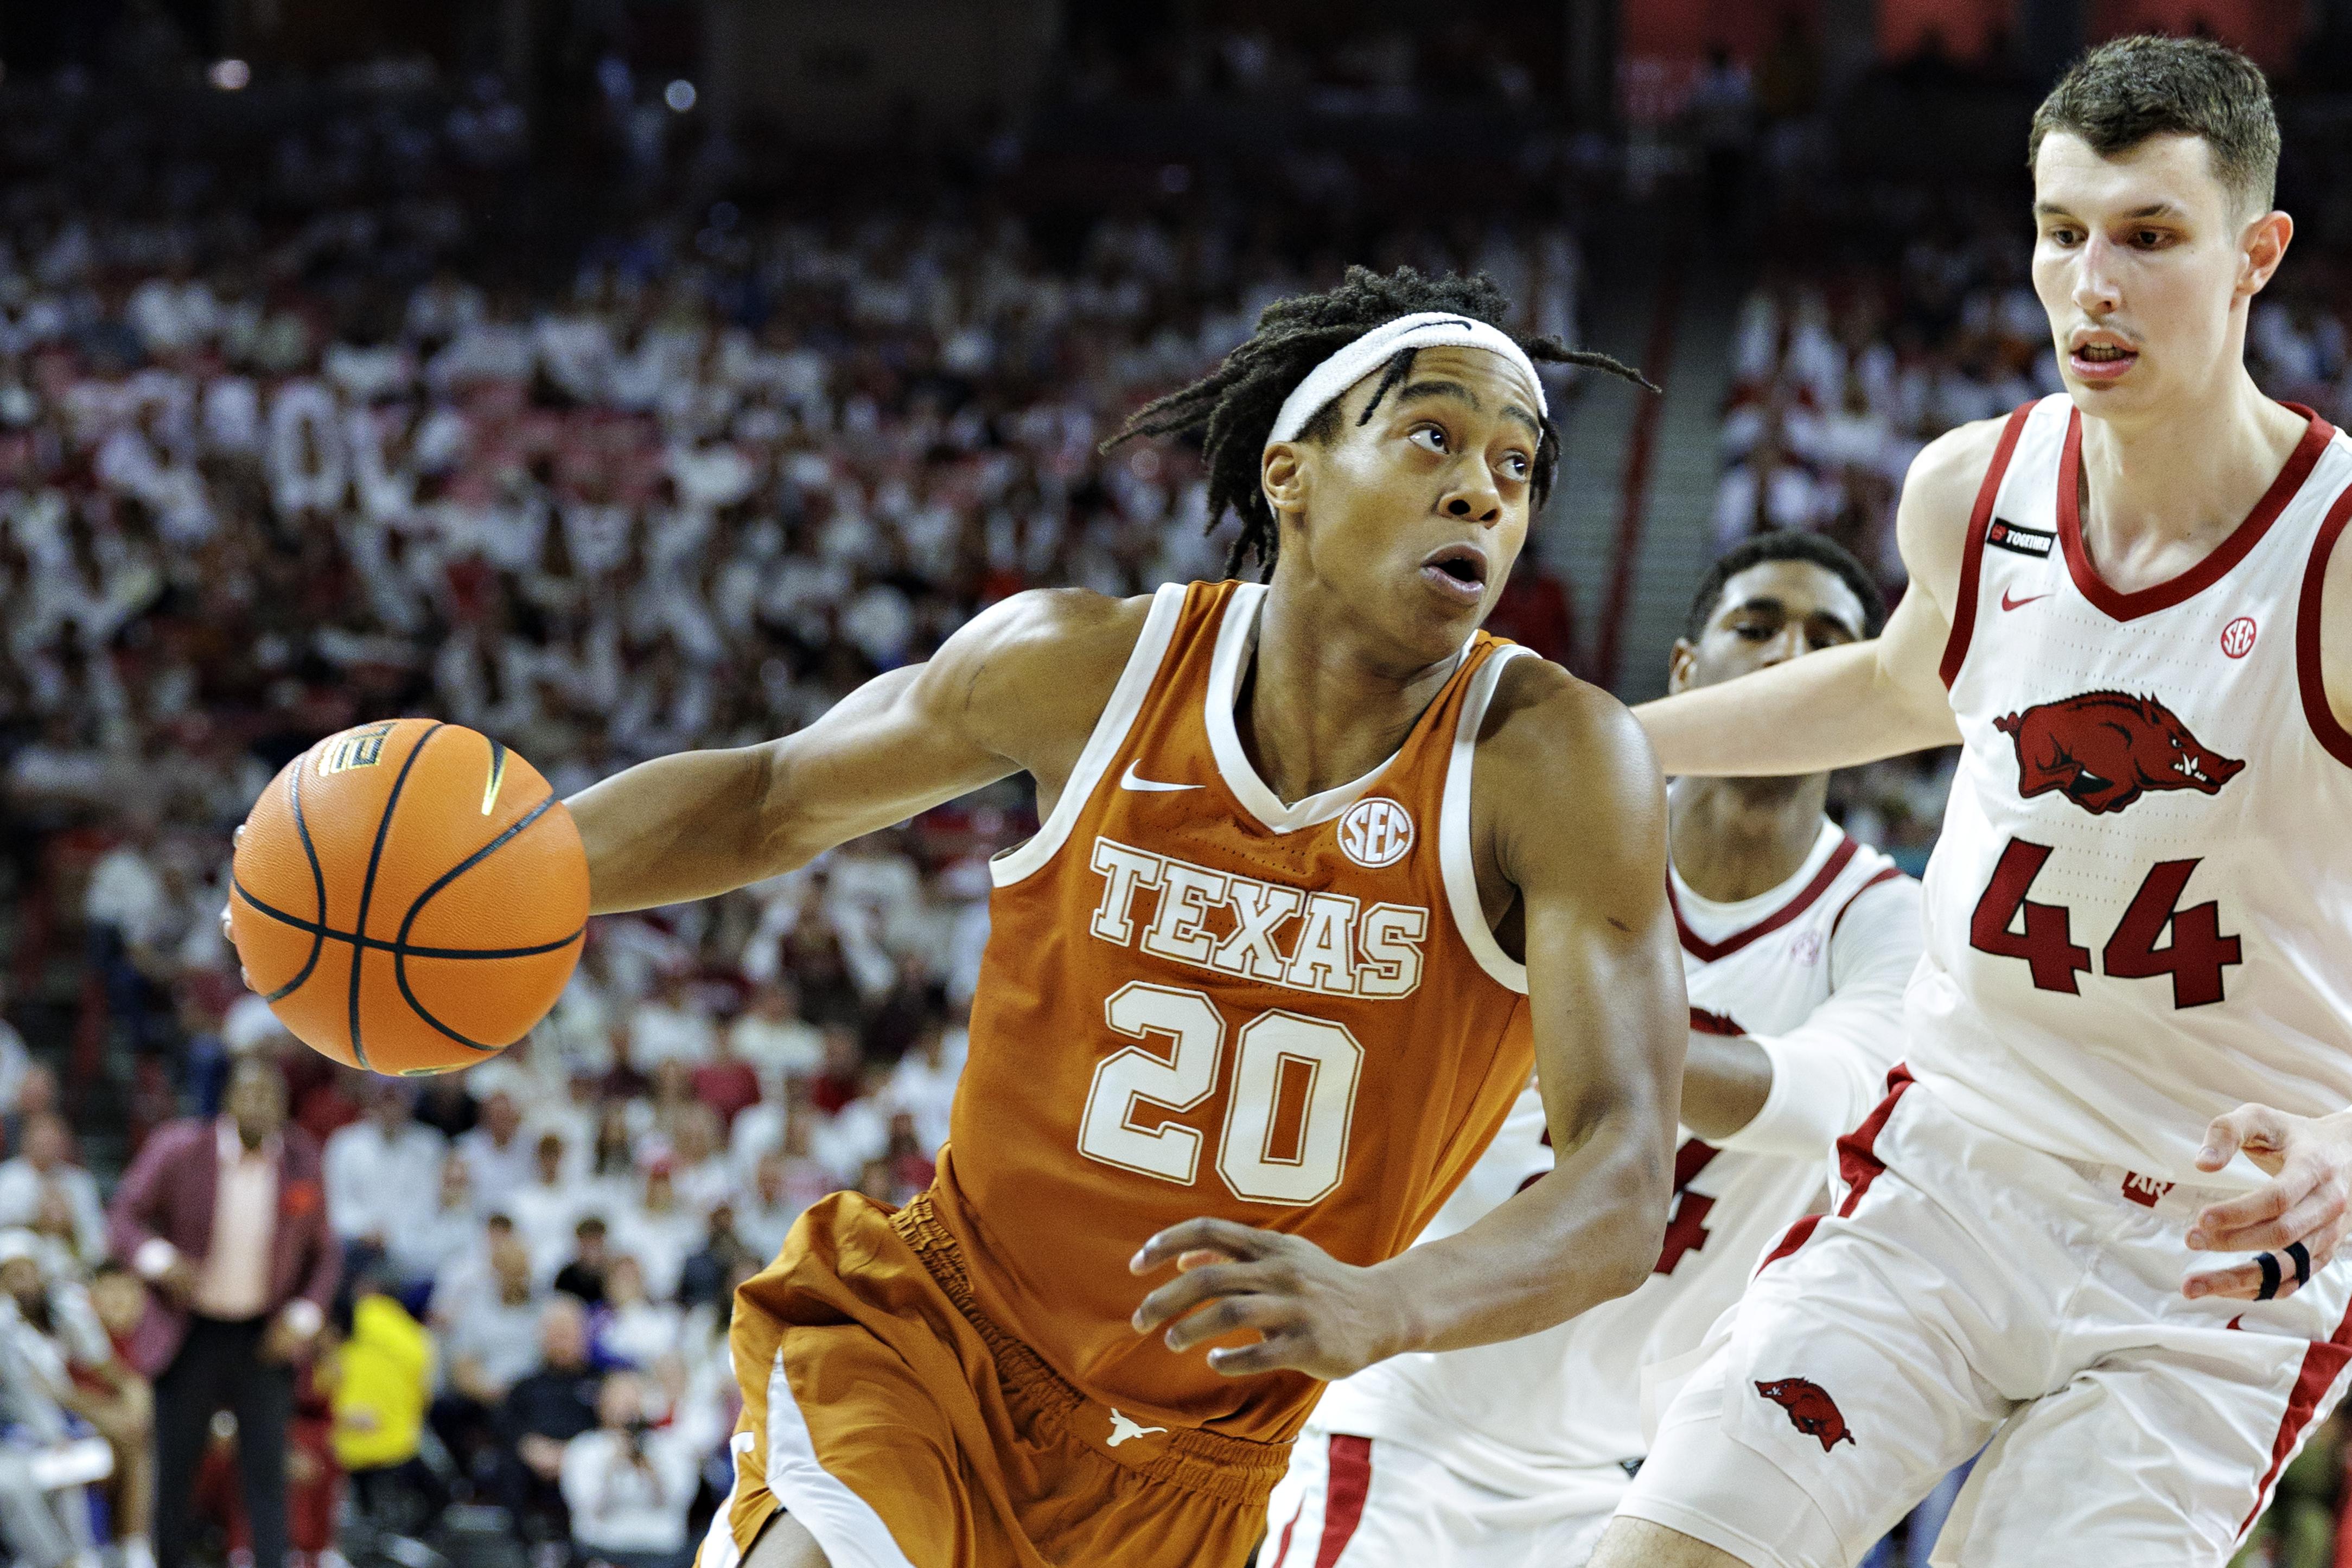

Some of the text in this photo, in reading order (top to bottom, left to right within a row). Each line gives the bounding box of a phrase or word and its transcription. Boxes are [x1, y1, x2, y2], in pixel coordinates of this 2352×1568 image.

[2223, 619, 2255, 655] SEC
[1343, 801, 1408, 862] SEC
[1089, 836, 1429, 1000] TEXAS
[1969, 836, 2242, 1010] 44
[1077, 980, 1366, 1206] 20
